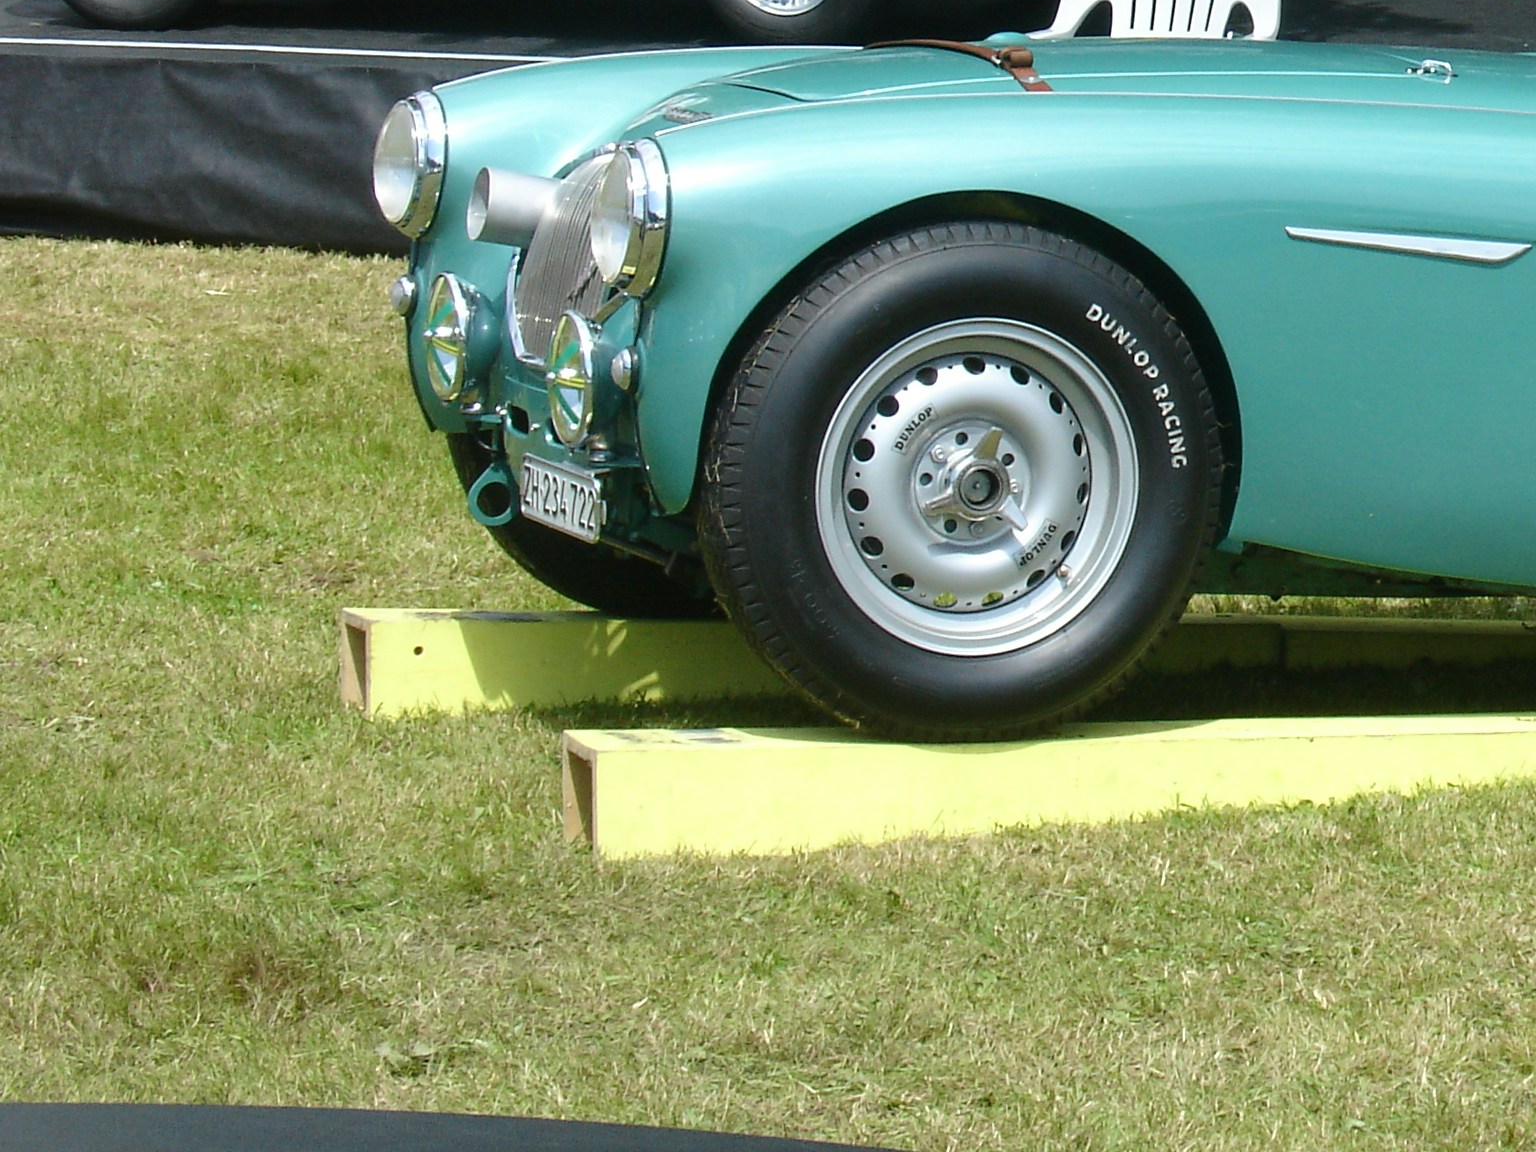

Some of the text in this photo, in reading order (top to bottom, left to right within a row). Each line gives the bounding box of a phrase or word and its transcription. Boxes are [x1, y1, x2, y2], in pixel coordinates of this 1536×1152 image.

[1085, 303, 1188, 469] DUNLOP RACING
[895, 406, 933, 451] DUNLOP
[1019, 523, 1058, 567] DUNLOP
